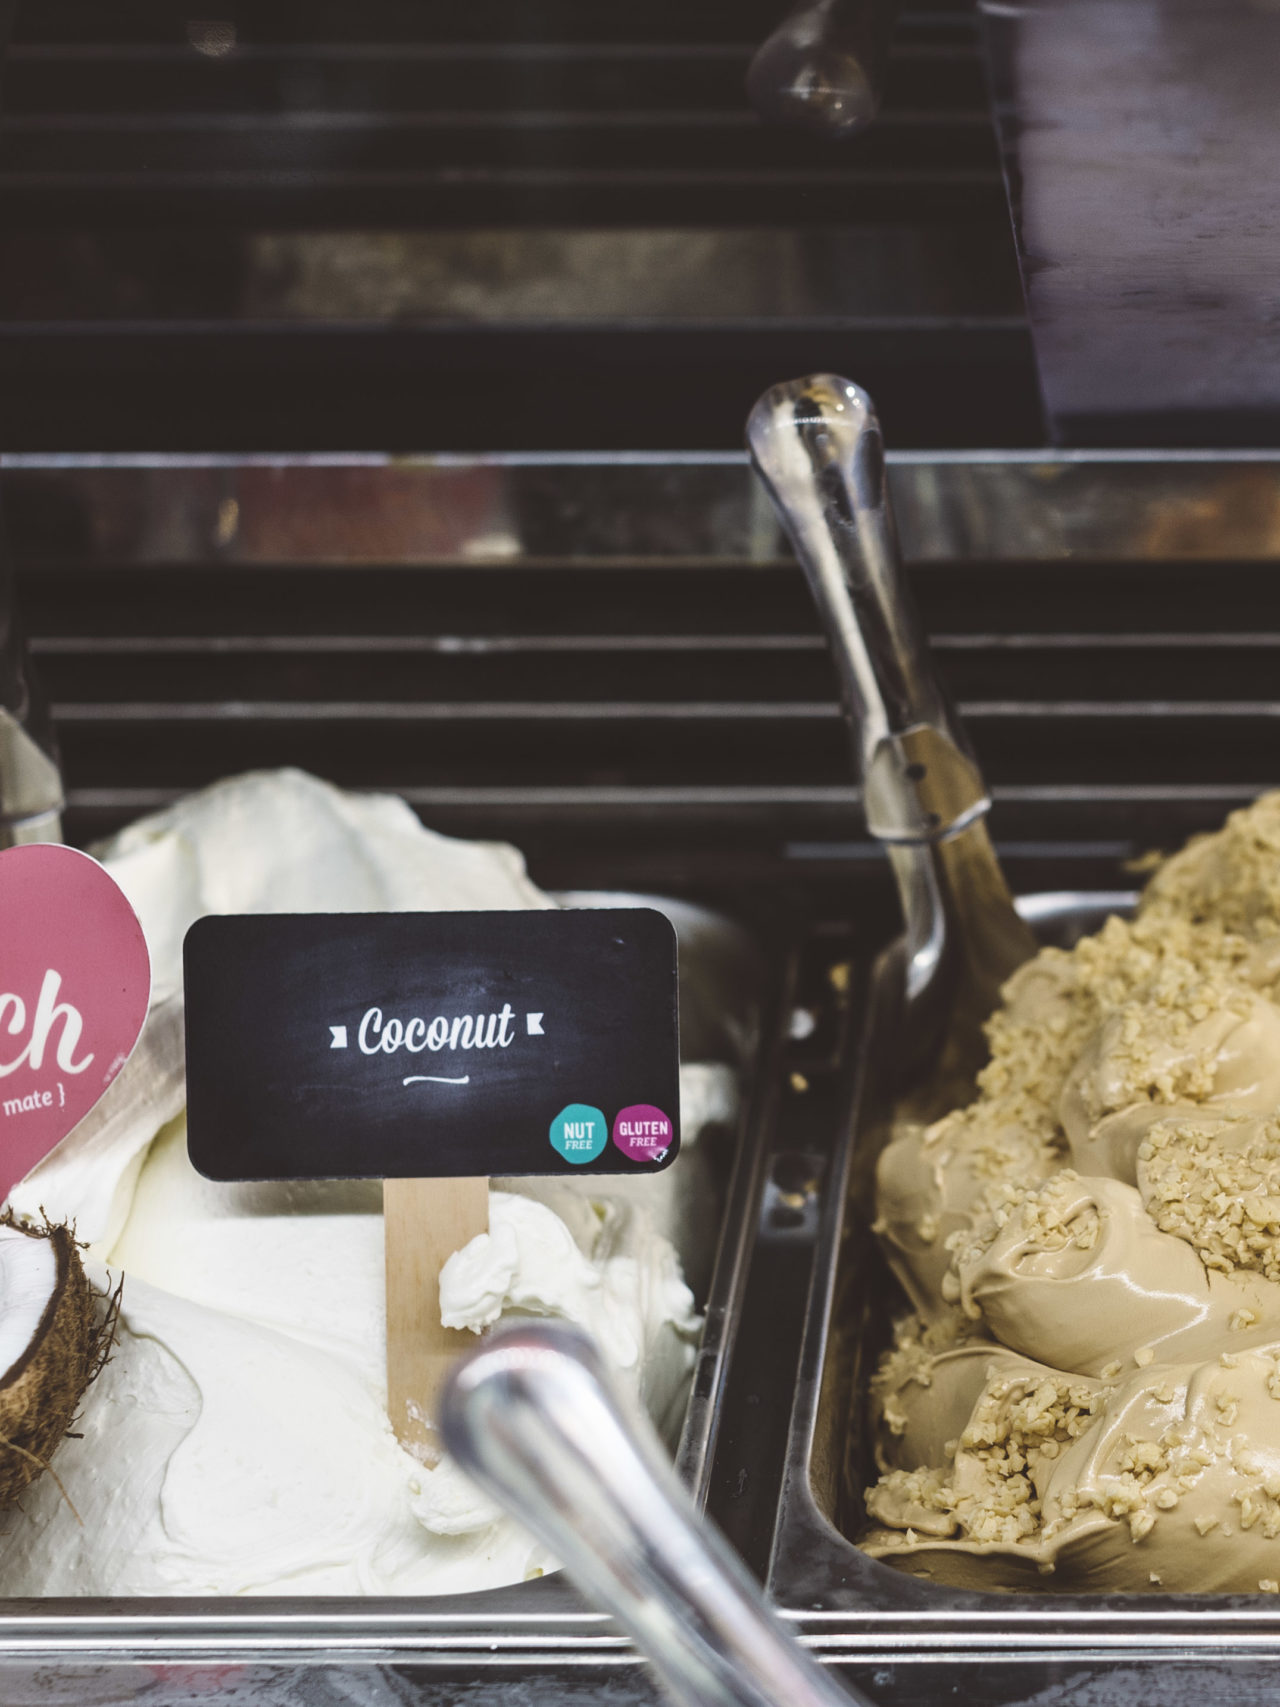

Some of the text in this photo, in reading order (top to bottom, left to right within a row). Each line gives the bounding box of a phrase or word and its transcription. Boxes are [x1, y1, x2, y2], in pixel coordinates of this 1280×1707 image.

[357, 1003, 515, 1055] Coconut
[2, 1089, 53, 1117] mate
[563, 1122, 595, 1139] NUT
[619, 1121, 668, 1136] GLUTEN
[564, 1140, 593, 1150] FREE
[629, 1137, 657, 1147] FREE
